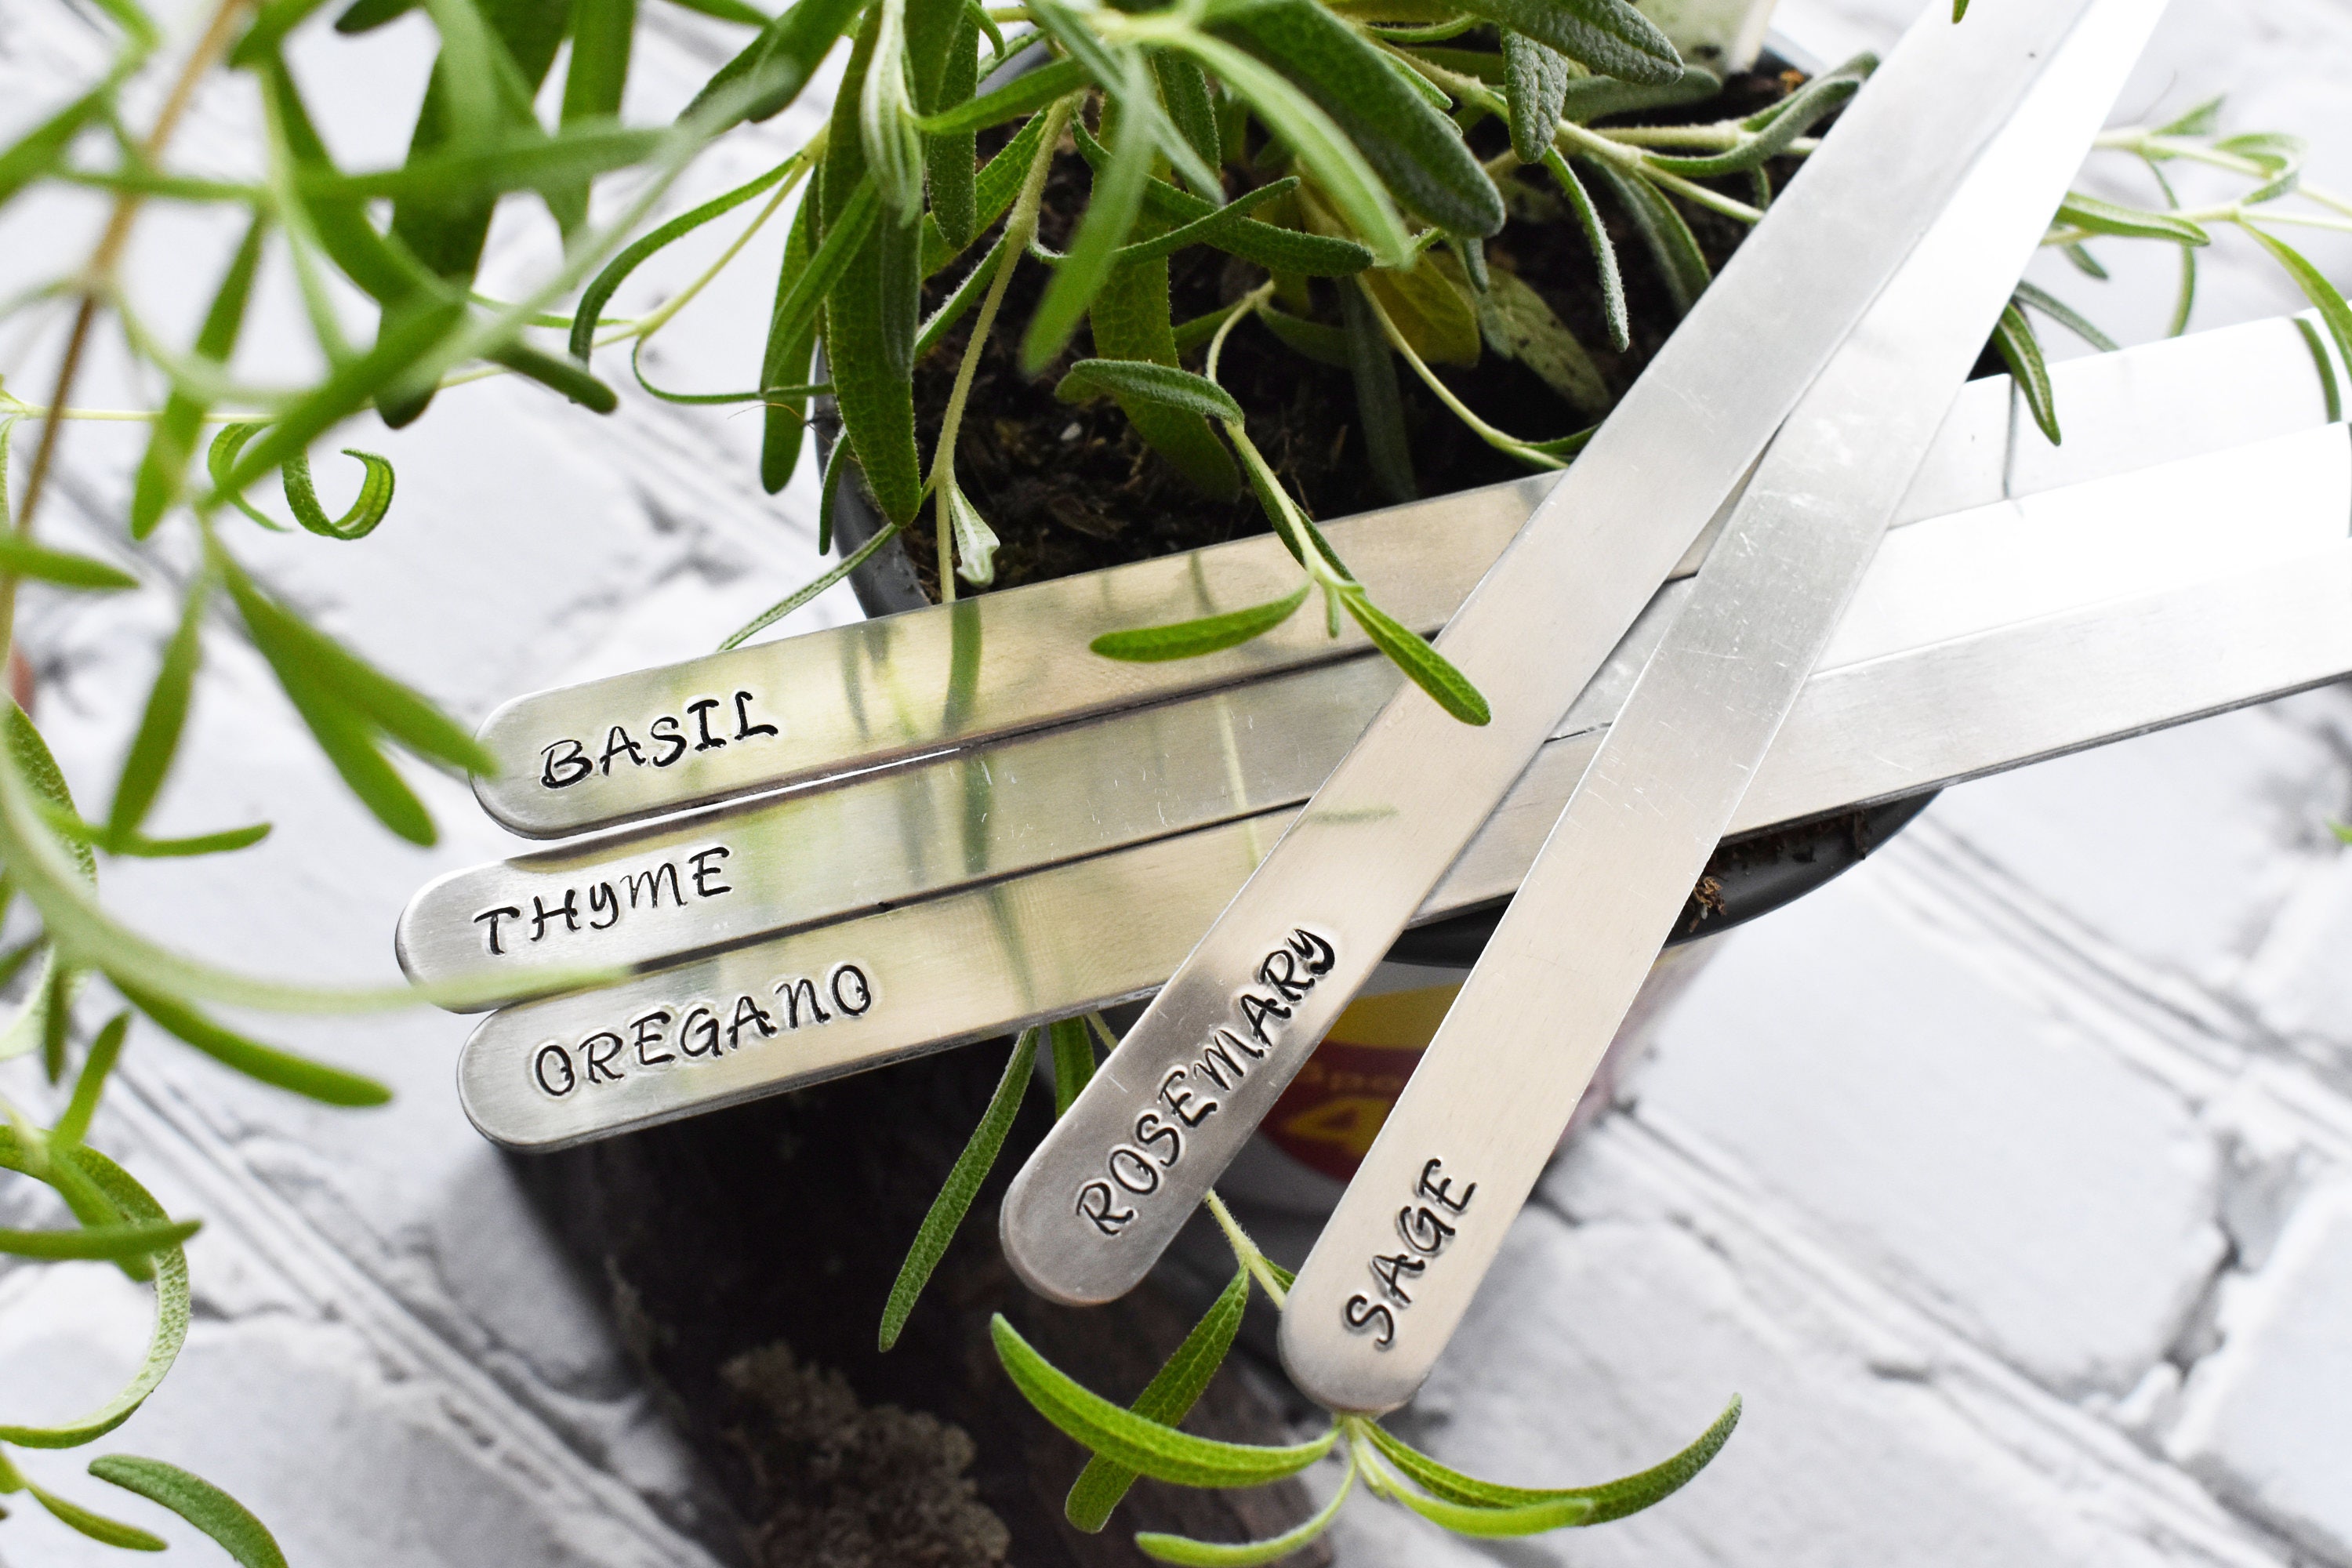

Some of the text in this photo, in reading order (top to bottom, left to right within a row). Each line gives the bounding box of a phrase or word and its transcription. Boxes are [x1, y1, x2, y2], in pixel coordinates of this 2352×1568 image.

[540, 691, 779, 789] BASIL
[474, 847, 731, 956] THYME
[535, 964, 872, 1096] OREGANO
[1076, 928, 1335, 1236] ROSEMARY
[1345, 1158, 1478, 1346] SAGE
